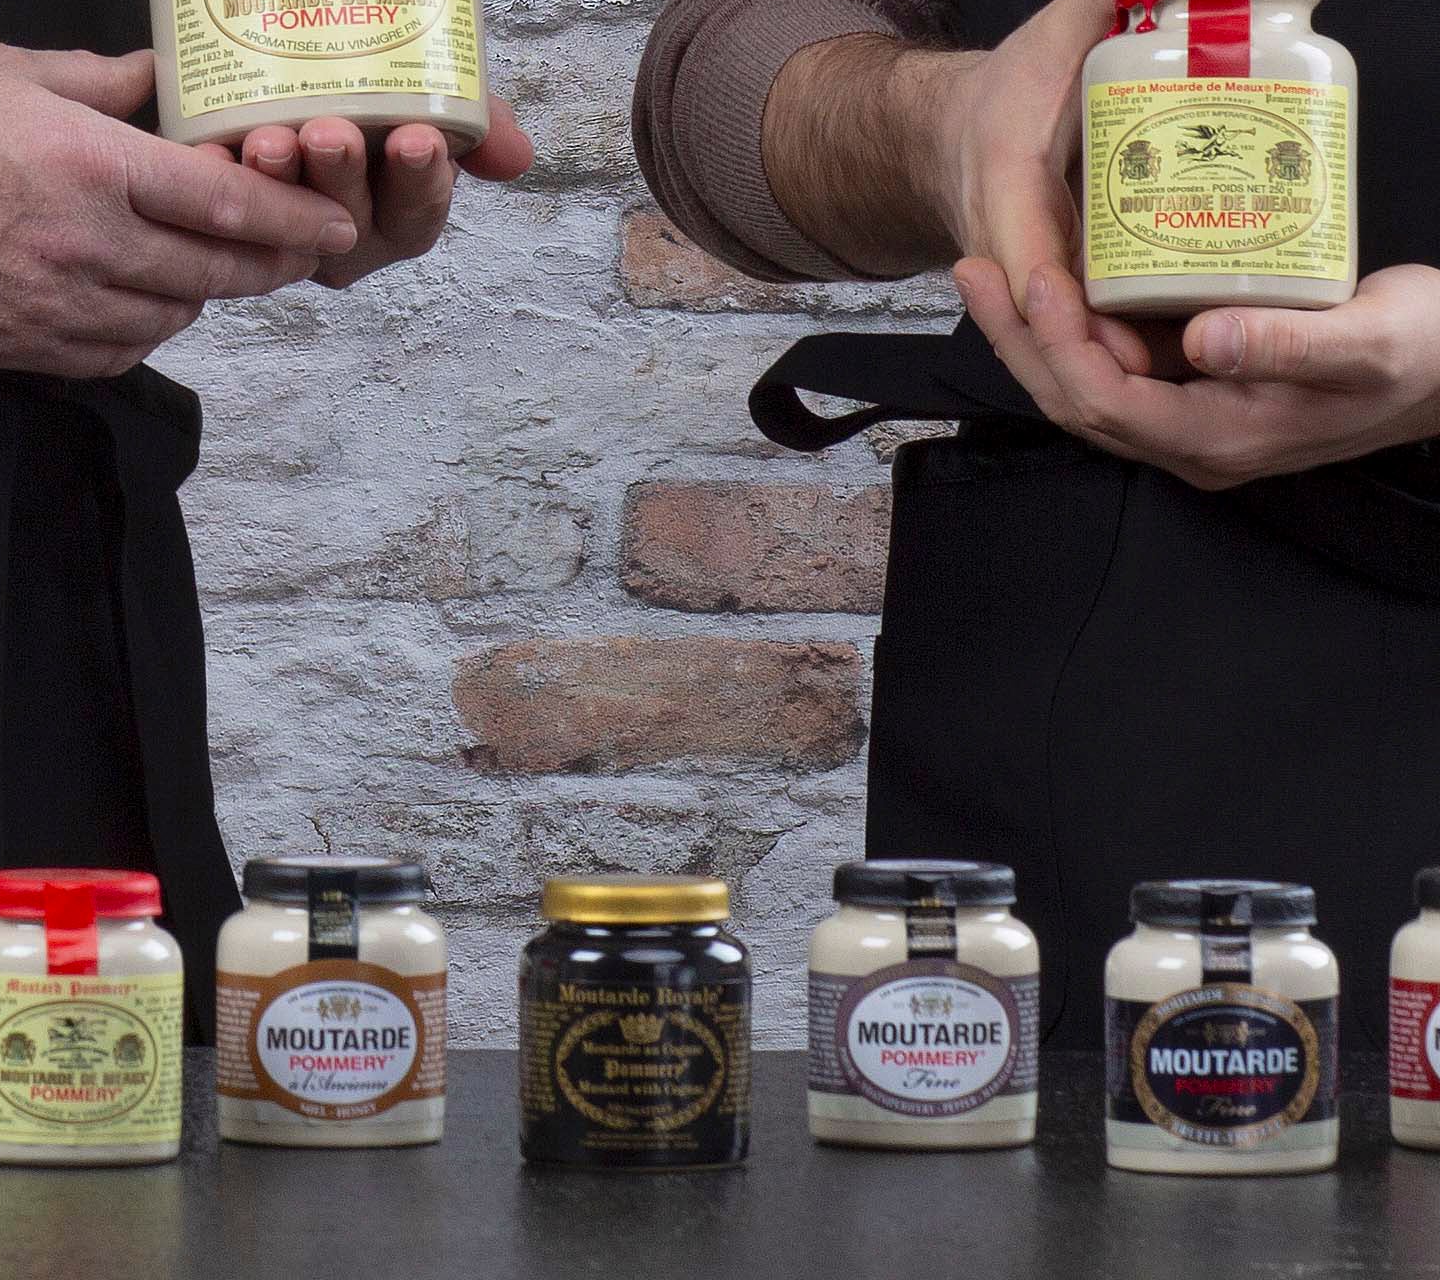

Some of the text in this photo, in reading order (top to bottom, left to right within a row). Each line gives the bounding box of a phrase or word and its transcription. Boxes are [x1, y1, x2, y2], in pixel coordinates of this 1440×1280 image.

[262, 5, 399, 32] POMMERY
[240, 17, 423, 52] AROMATISÉE AU VINAIGRE FIN
[344, 78, 355, 88] la
[358, 77, 404, 89] Moutarde
[1138, 84, 1146, 93] la
[1149, 82, 1203, 93] Moutarde
[1206, 82, 1221, 92] de
[1212, 183, 1244, 193] POIDS
[1247, 184, 1266, 192] NET
[1269, 184, 1285, 194] 250
[1120, 194, 1313, 215] MOUTARDE DE MEAUX
[1154, 211, 1273, 229] POMMERY
[1132, 222, 1203, 249] AROMATISÉE
[1205, 239, 1223, 249] AU
[1225, 231, 1281, 249] VINAIGRE
[1282, 222, 1299, 236] FIN
[267, 1026, 411, 1051] MOUTARDE
[858, 1021, 1002, 1046] MOUTARDE
[288, 1054, 387, 1072] POMMERY
[880, 1049, 978, 1067] POMMERY
[1150, 1046, 1298, 1075] MOUTARDE
[903, 1067, 961, 1090] Fine
[30, 1086, 117, 1103] POMMERY
